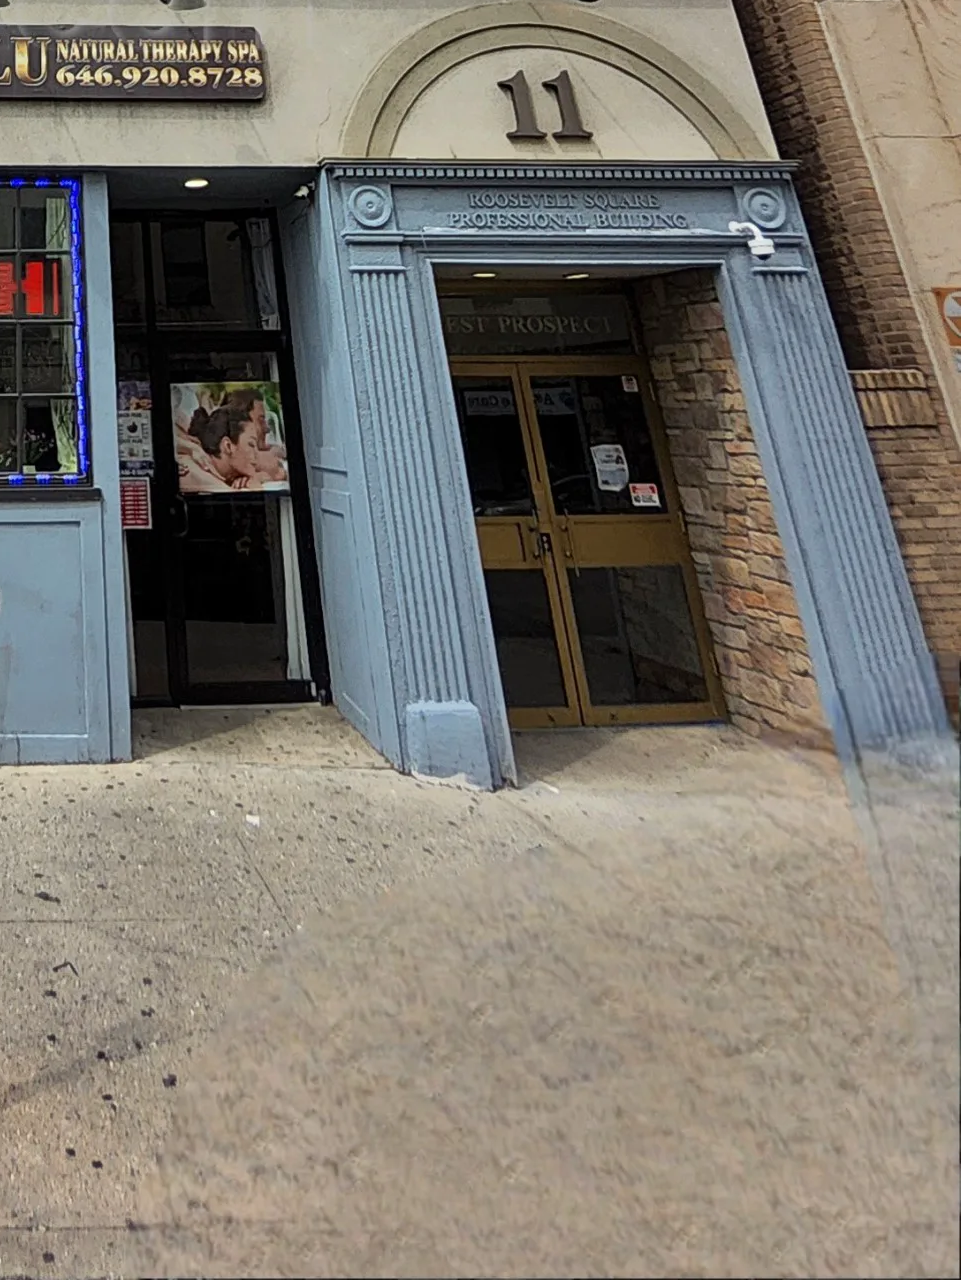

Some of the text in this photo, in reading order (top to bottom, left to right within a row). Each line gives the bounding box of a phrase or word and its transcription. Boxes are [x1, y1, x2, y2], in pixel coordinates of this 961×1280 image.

[56, 38, 263, 64] NATURAL THERAPY SPA
[56, 64, 263, 89] 646.920.8728
[497, 69, 594, 140] 11
[467, 192, 662, 211] ROOSEVELT SQUARE
[446, 211, 688, 230] PROFESSIONAL BUILDING
[446, 316, 613, 333] EST PROSPECT
